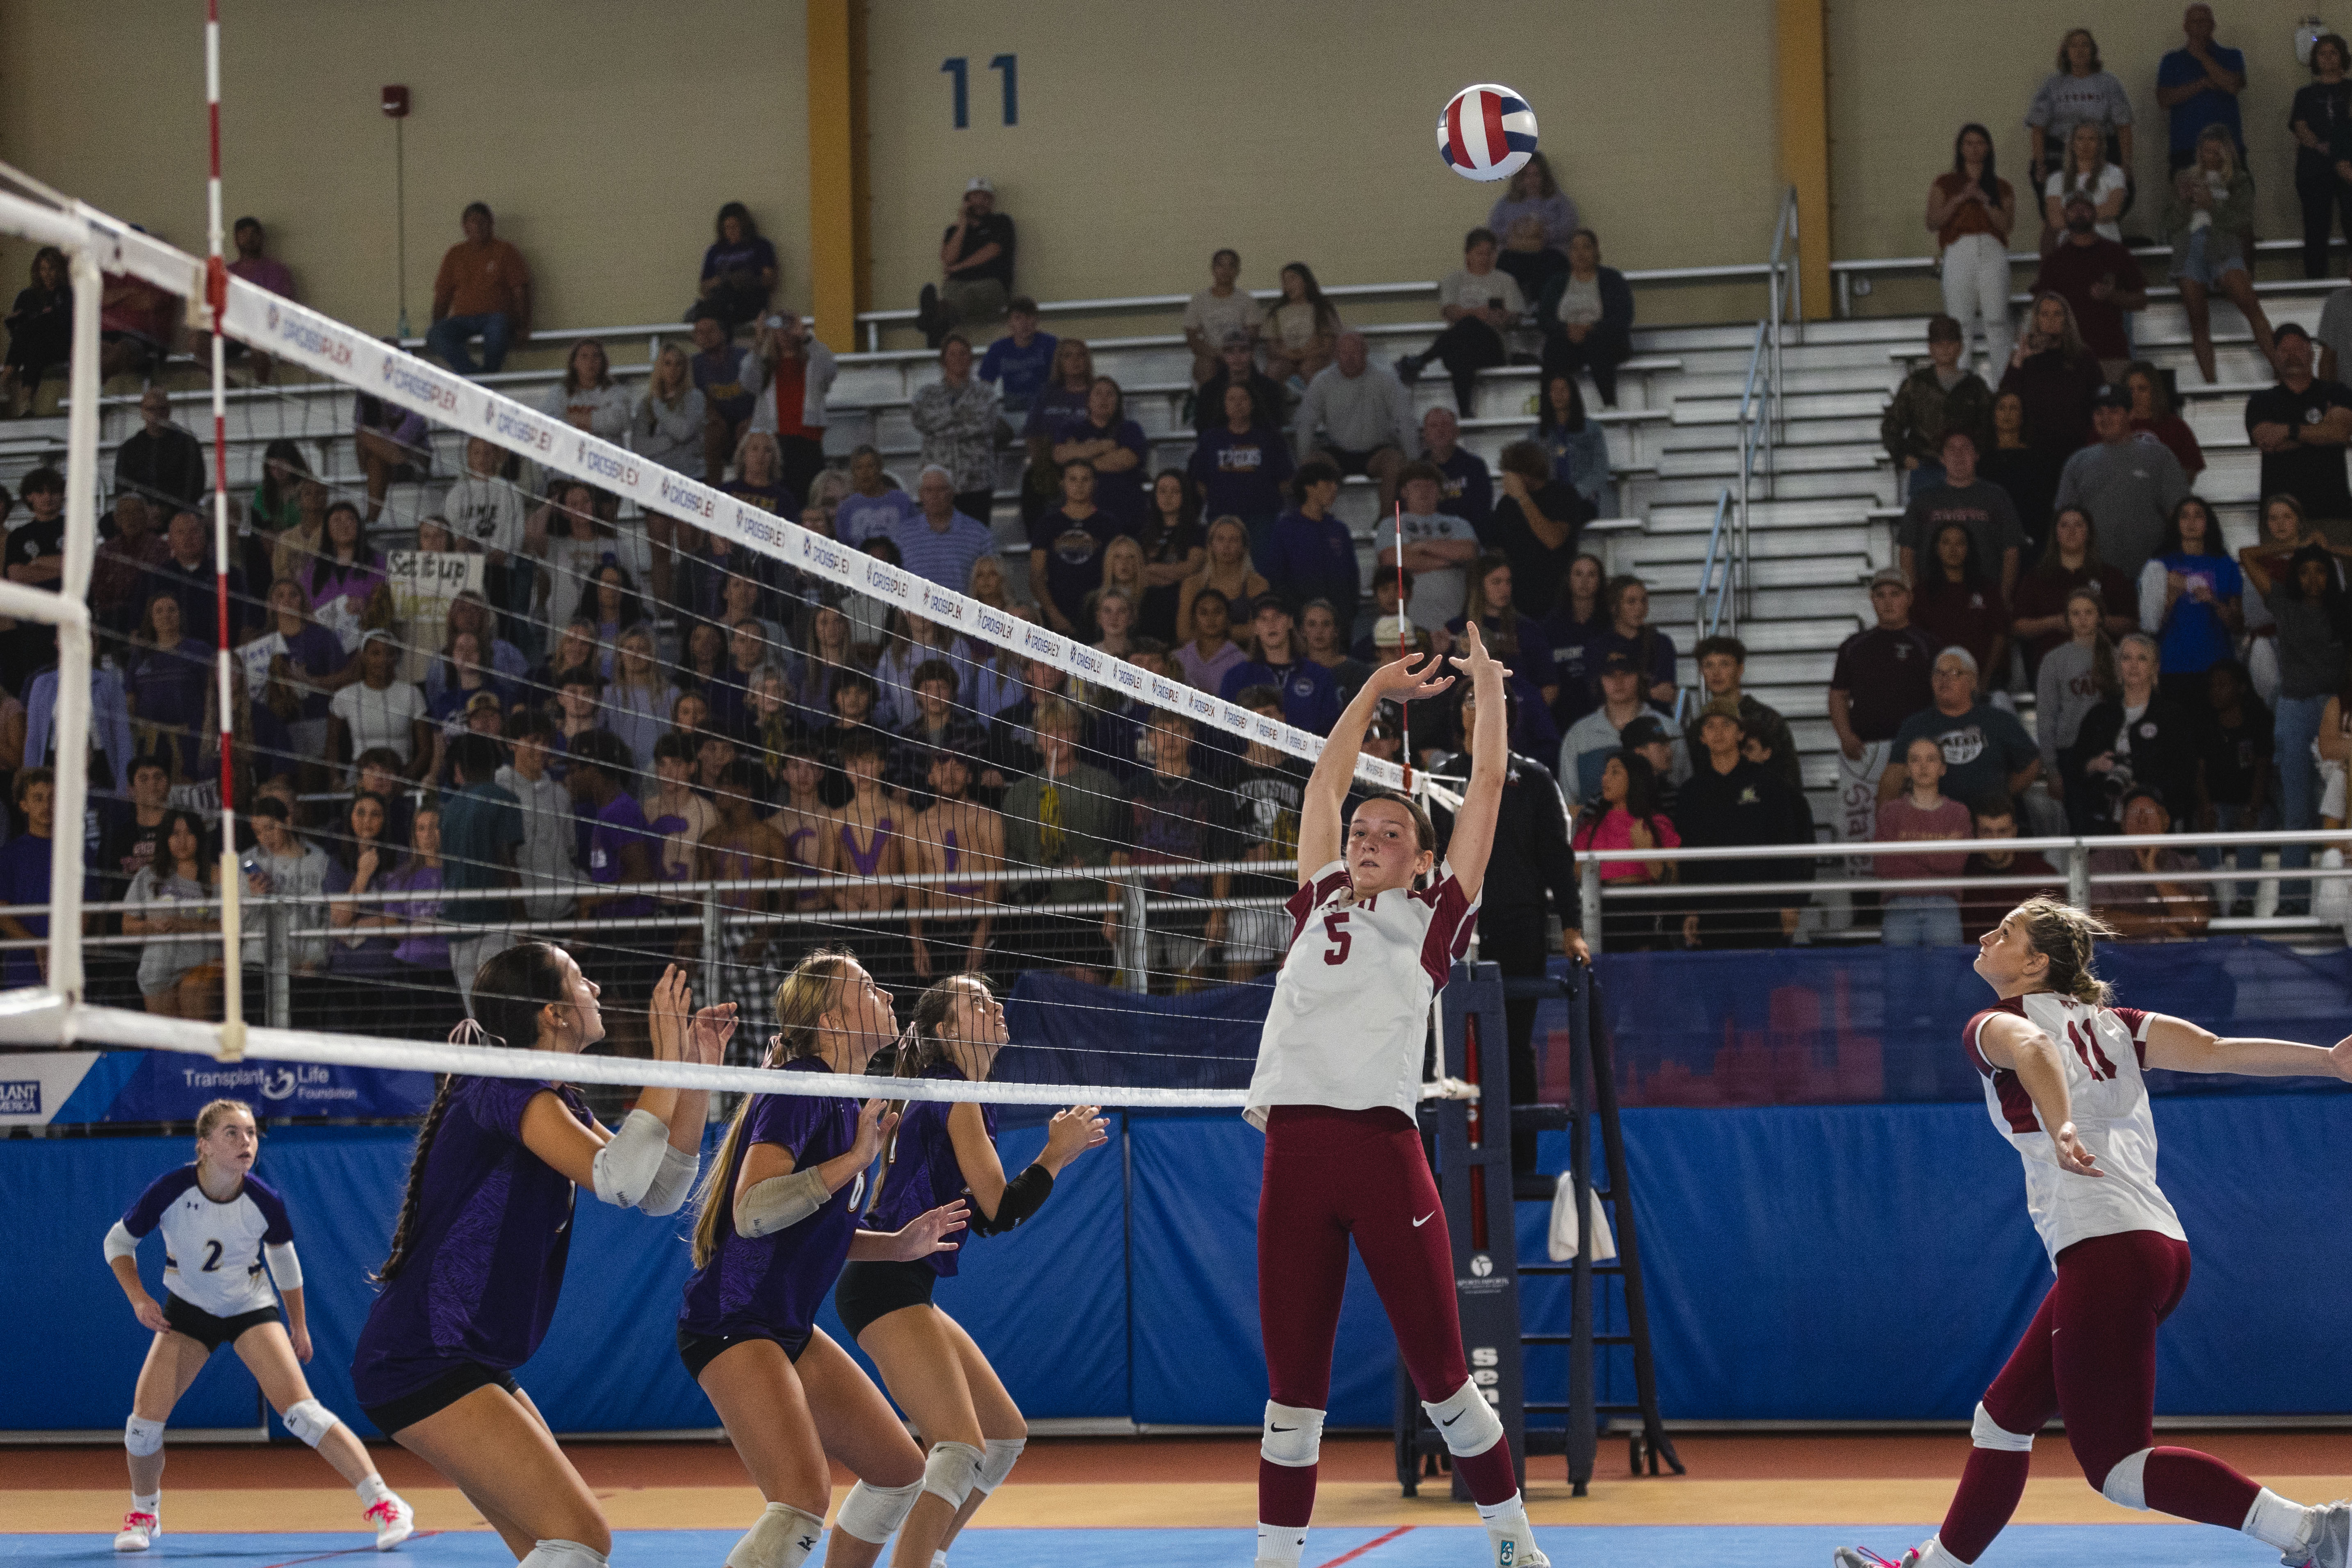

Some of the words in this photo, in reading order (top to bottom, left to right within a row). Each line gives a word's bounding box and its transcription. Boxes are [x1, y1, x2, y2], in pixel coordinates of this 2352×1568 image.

[940, 53, 1019, 130] 11
[813, 546, 850, 574] CROSSPE
[1156, 684, 1179, 704] CROSPLE
[1194, 699, 1215, 718] ROSSPEX
[1227, 712, 1248, 729] CROSSPEX
[1324, 912, 1352, 965] 5
[2067, 1019, 2117, 1082] 11
[184, 1068, 264, 1089] Transplant
[297, 1065, 329, 1083] Life
[298, 1087, 357, 1099] Foundation
[202, 1240, 224, 1272] 2
